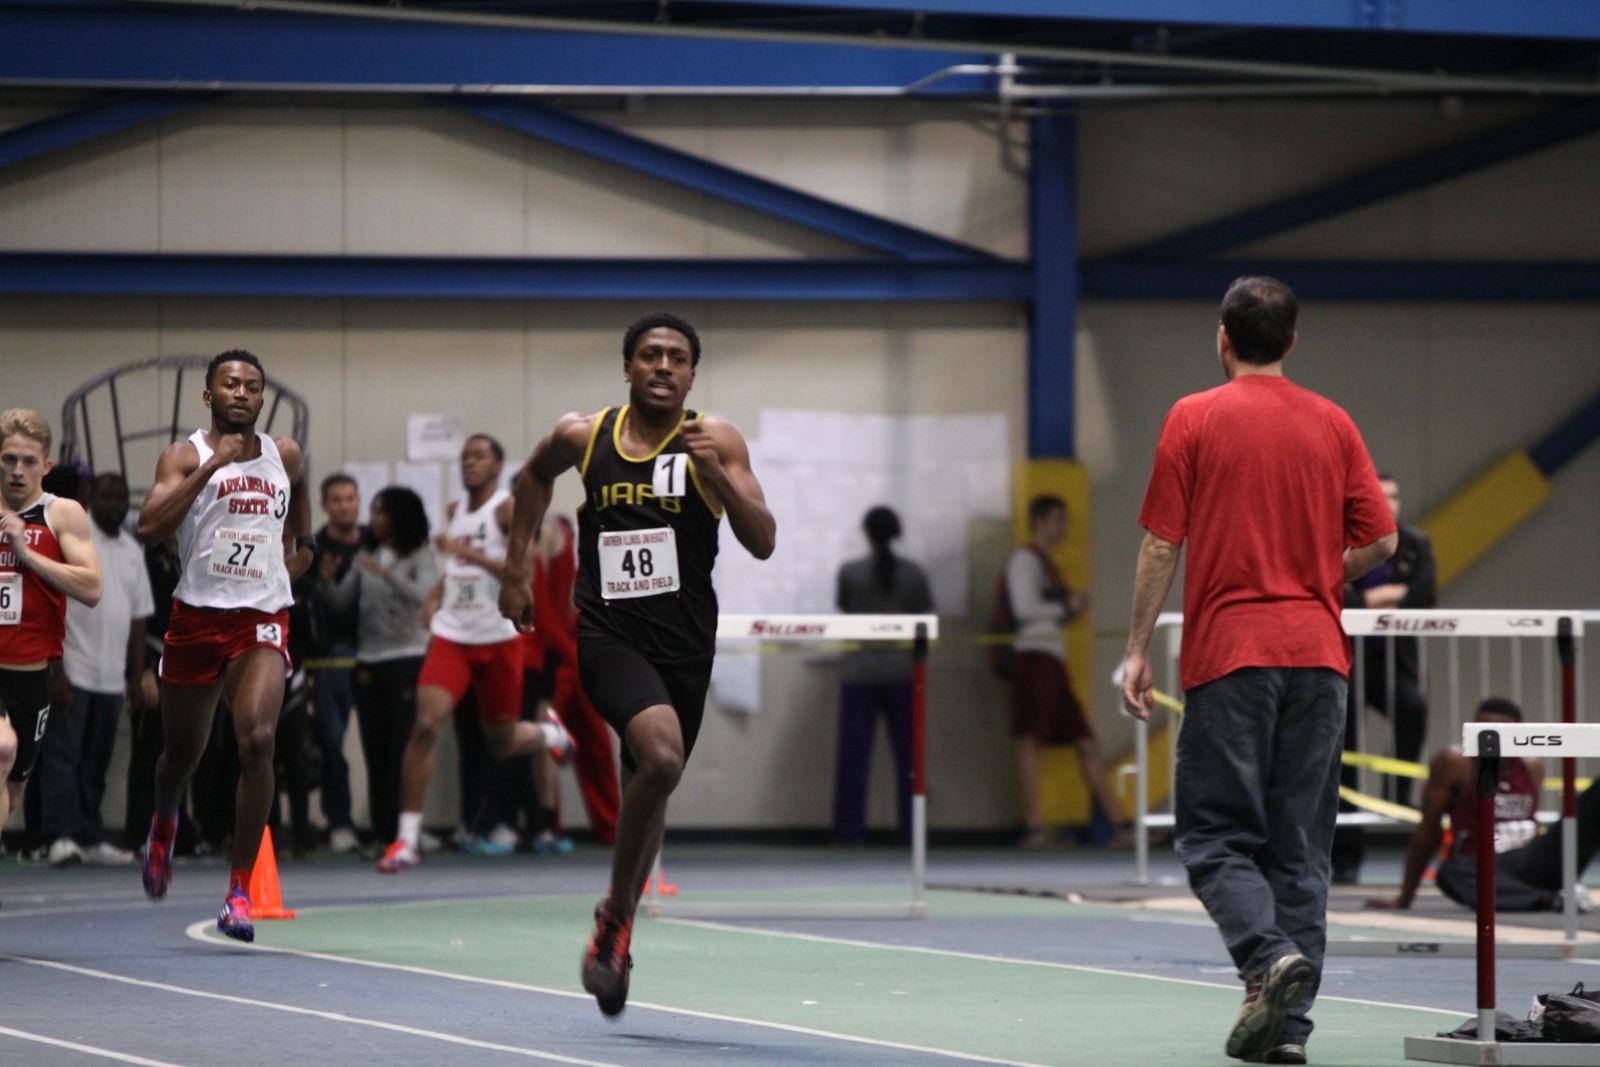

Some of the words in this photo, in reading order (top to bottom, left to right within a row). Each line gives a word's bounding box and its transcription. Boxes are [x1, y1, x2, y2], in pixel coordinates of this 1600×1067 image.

[661, 455, 677, 494] 1
[229, 498, 269, 515] STATE
[274, 489, 286, 519] 3
[227, 542, 255, 567] 27
[212, 563, 233, 575] TRACK
[233, 567, 246, 577] AND
[246, 569, 263, 579] FIELD
[621, 548, 654, 579] 48
[606, 581, 631, 593] TRACK
[633, 579, 650, 591] AND
[652, 576, 673, 589] FIELD
[1508, 618, 1544, 628] UCS
[262, 624, 278, 641] 3
[1513, 735, 1563, 746] UCS
[1397, 943, 1439, 953] UCS
